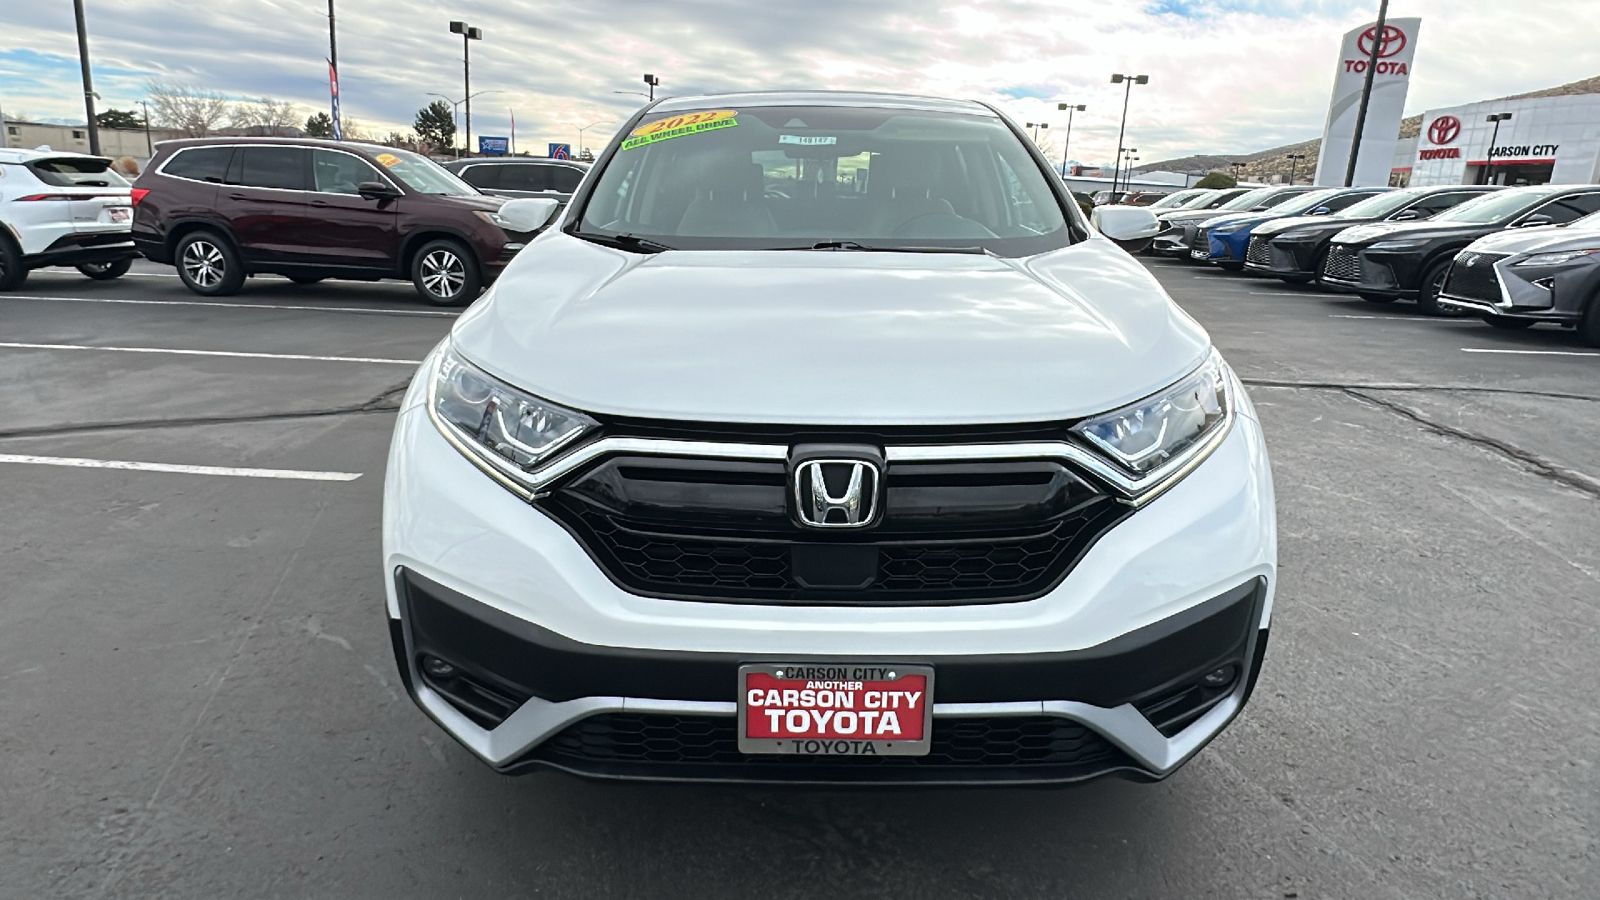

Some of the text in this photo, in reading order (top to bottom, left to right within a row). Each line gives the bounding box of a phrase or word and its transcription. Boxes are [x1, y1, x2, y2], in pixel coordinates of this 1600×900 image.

[1344, 59, 1408, 75] TOOTA
[649, 112, 718, 133] 2022
[650, 126, 695, 141] WHEEL
[1419, 147, 1460, 160] TOYOTA
[1532, 144, 1559, 156] CITY
[785, 666, 888, 681] CARSON CITY
[806, 681, 863, 690] ANOTHER
[747, 689, 922, 709] CARSON CITY
[764, 709, 902, 734] TOYOTA
[791, 740, 877, 754] TOYOTA
